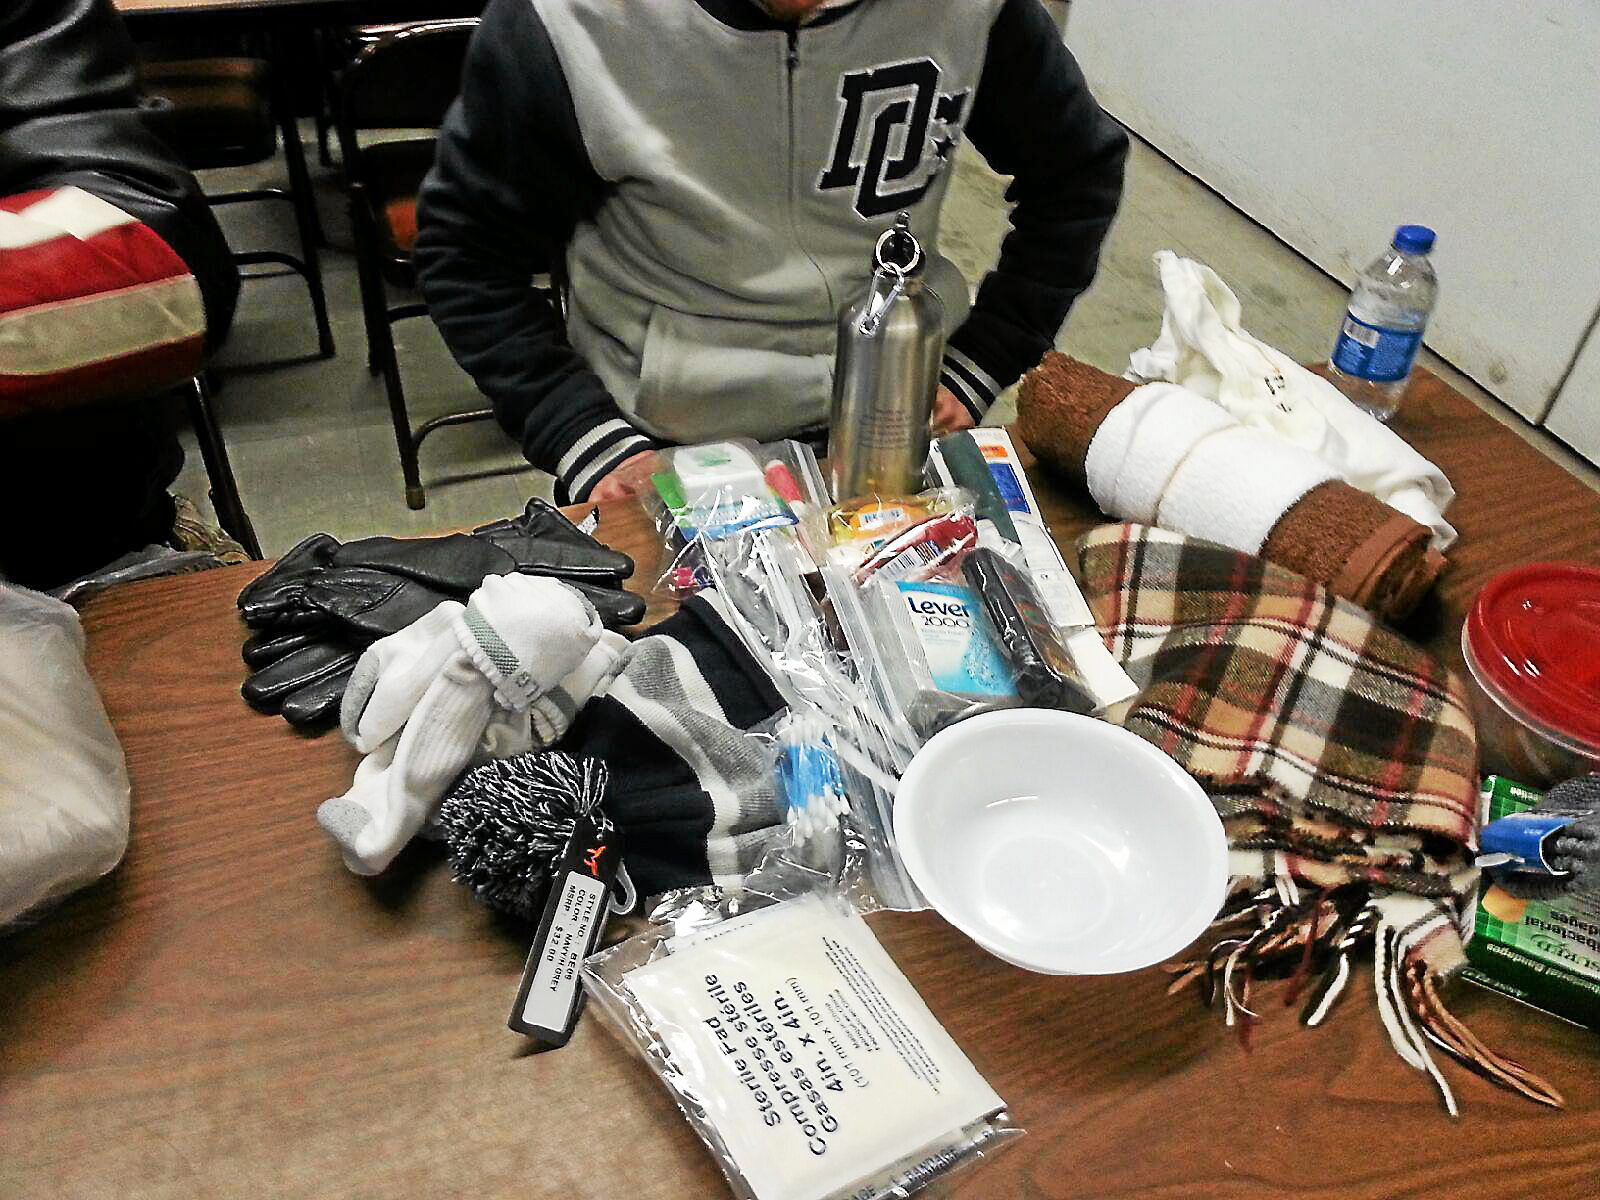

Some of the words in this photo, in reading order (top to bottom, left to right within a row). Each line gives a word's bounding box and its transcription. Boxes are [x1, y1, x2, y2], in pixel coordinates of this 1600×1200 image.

[907, 596, 970, 618] Lever
[921, 615, 970, 628] 2000
[563, 884, 576, 912] MSRP
[582, 893, 596, 922] STYLE
[705, 974, 748, 1032] stérile
[774, 990, 800, 1028] 4in.
[805, 1006, 823, 1025] 101
[733, 981, 793, 1063] estériles
[798, 1032, 815, 1047] x
[828, 1036, 847, 1059] mm
[815, 1051, 844, 1091] 4in.
[844, 1062, 870, 1088] (101
[735, 1058, 781, 1127] Sterile
[745, 1035, 827, 1155] Compresse
[790, 1067, 838, 1132] Gasas
